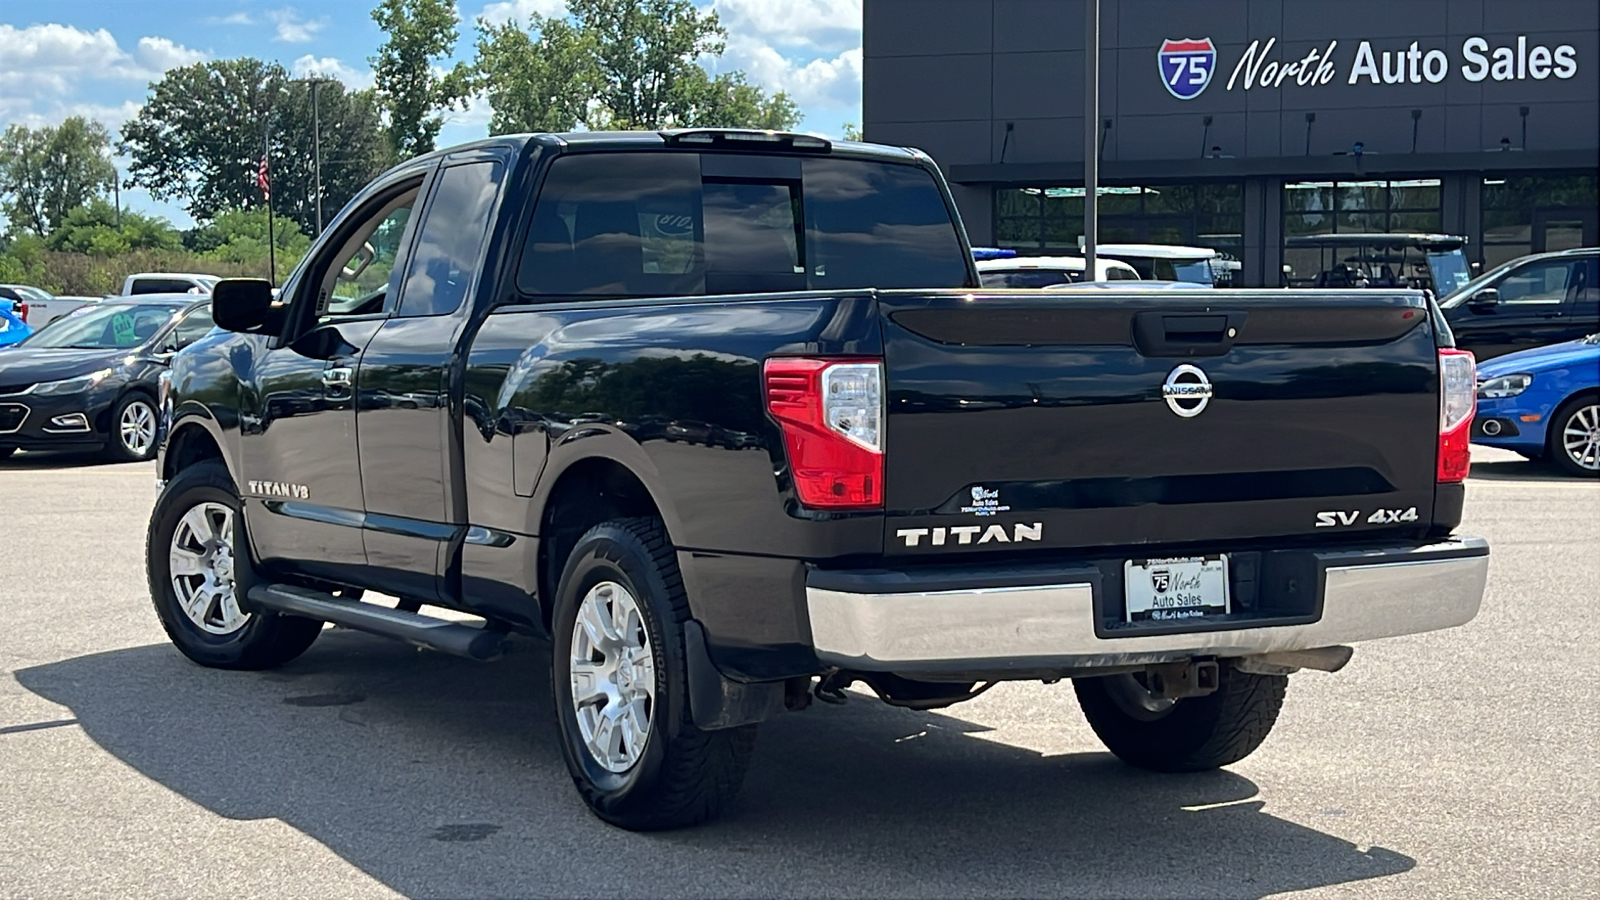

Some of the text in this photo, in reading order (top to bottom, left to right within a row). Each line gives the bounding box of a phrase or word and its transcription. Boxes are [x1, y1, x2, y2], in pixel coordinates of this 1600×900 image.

[1168, 35, 1578, 91] 75 North Auto Sales
[1169, 386, 1209, 395] NISSAN
[248, 480, 309, 500] TITAN V8
[1315, 509, 1360, 528] SV
[896, 522, 1043, 546] TITAN
[1154, 571, 1201, 592] 75 North
[1152, 593, 1202, 608] Auto Sales
